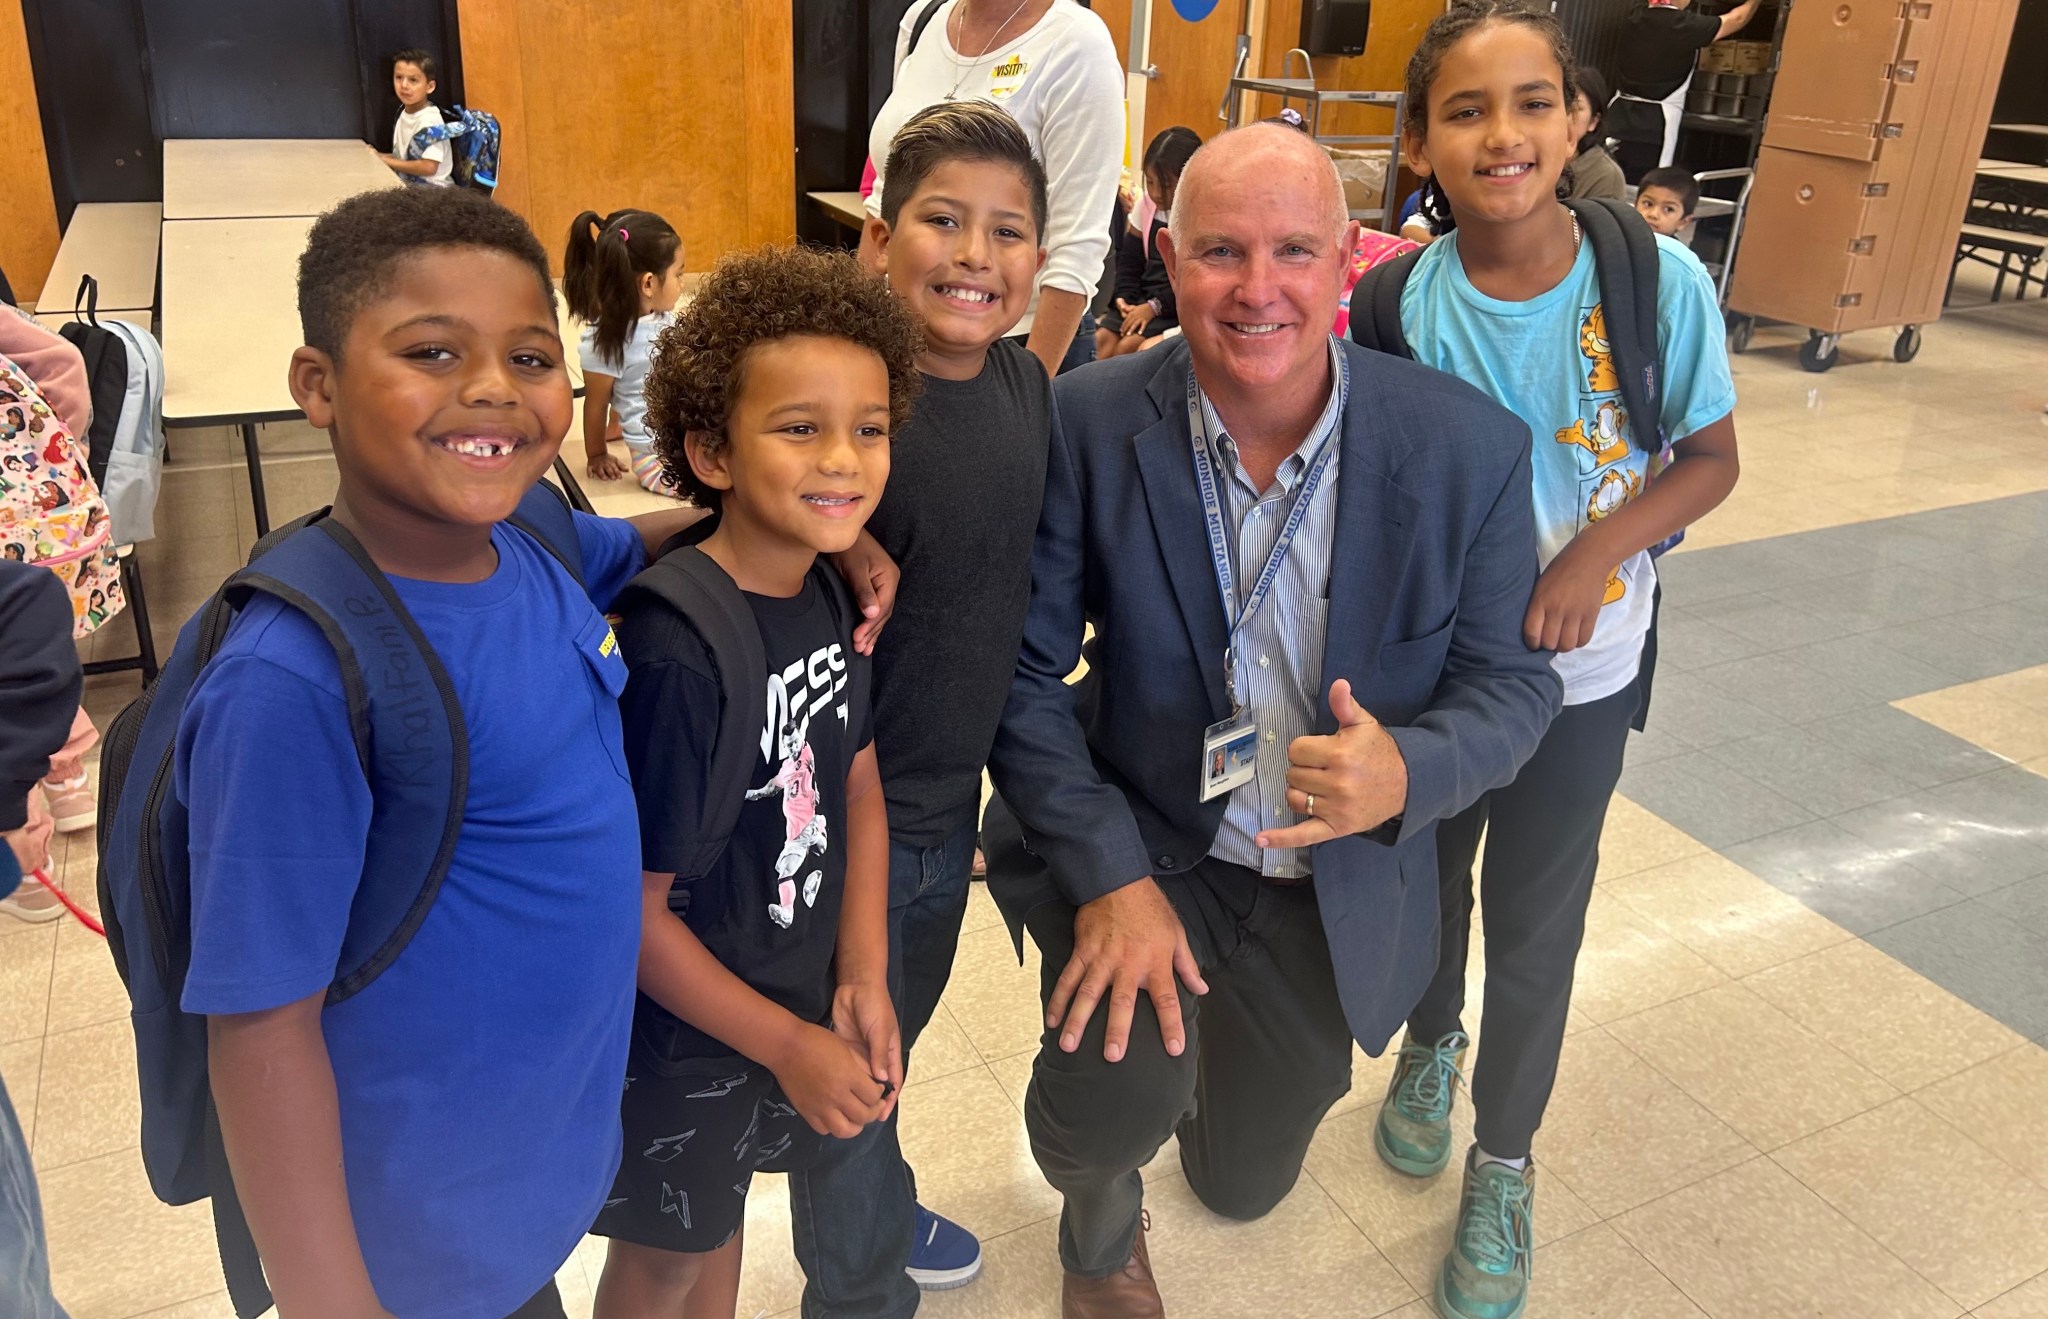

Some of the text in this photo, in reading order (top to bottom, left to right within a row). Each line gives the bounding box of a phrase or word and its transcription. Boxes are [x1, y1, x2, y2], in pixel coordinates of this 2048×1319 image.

[1196, 450, 1232, 590] MONROE MUSTANGS
[1255, 464, 1322, 597] MONROE MUSTANGS
[598, 624, 617, 659] NEVE
[760, 643, 849, 765] MESS
[1240, 754, 1255, 767] STAFF
